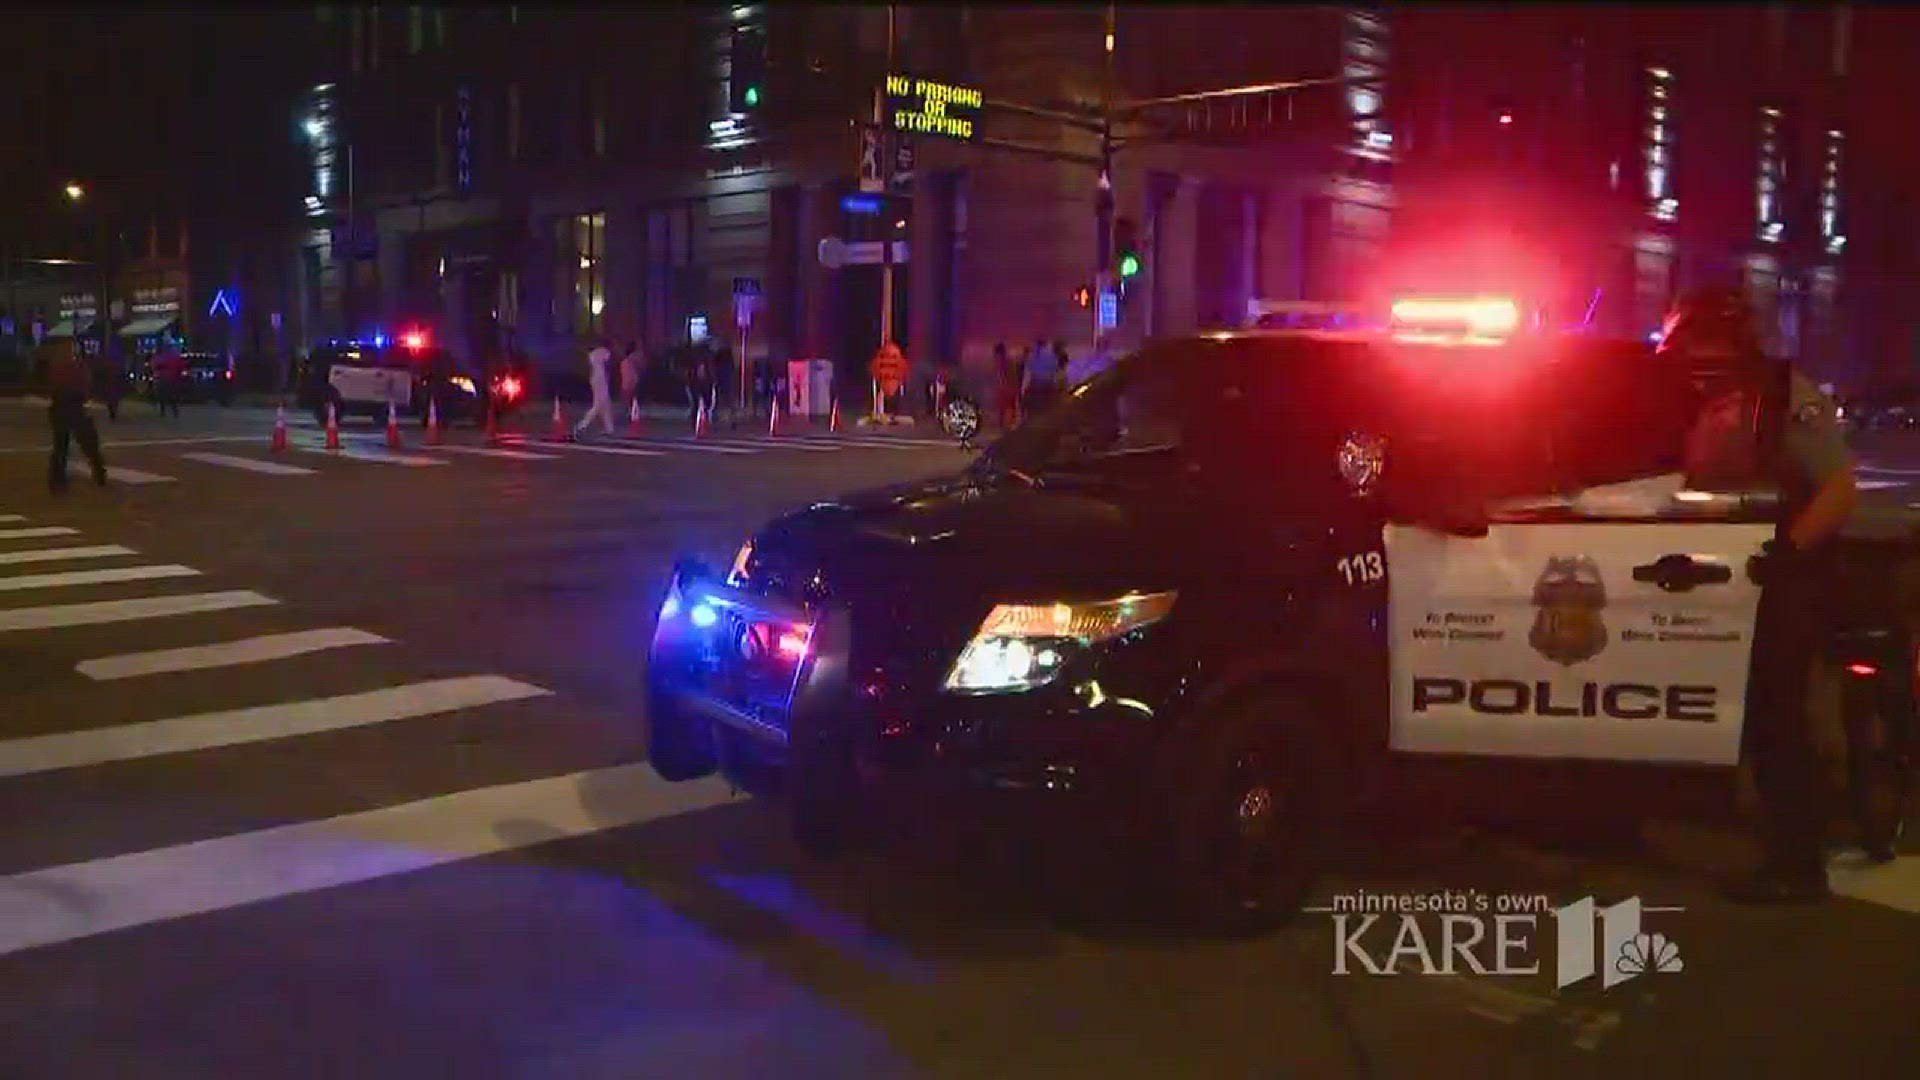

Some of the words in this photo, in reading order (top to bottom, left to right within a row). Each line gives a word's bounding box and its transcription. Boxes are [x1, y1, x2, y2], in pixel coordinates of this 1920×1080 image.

[886, 75, 910, 96] NO
[915, 80, 983, 109] PARKING
[924, 99, 946, 118] OR
[894, 111, 973, 138] STOPPING
[1337, 552, 1385, 586] 113
[1413, 677, 1719, 722] POLICE
